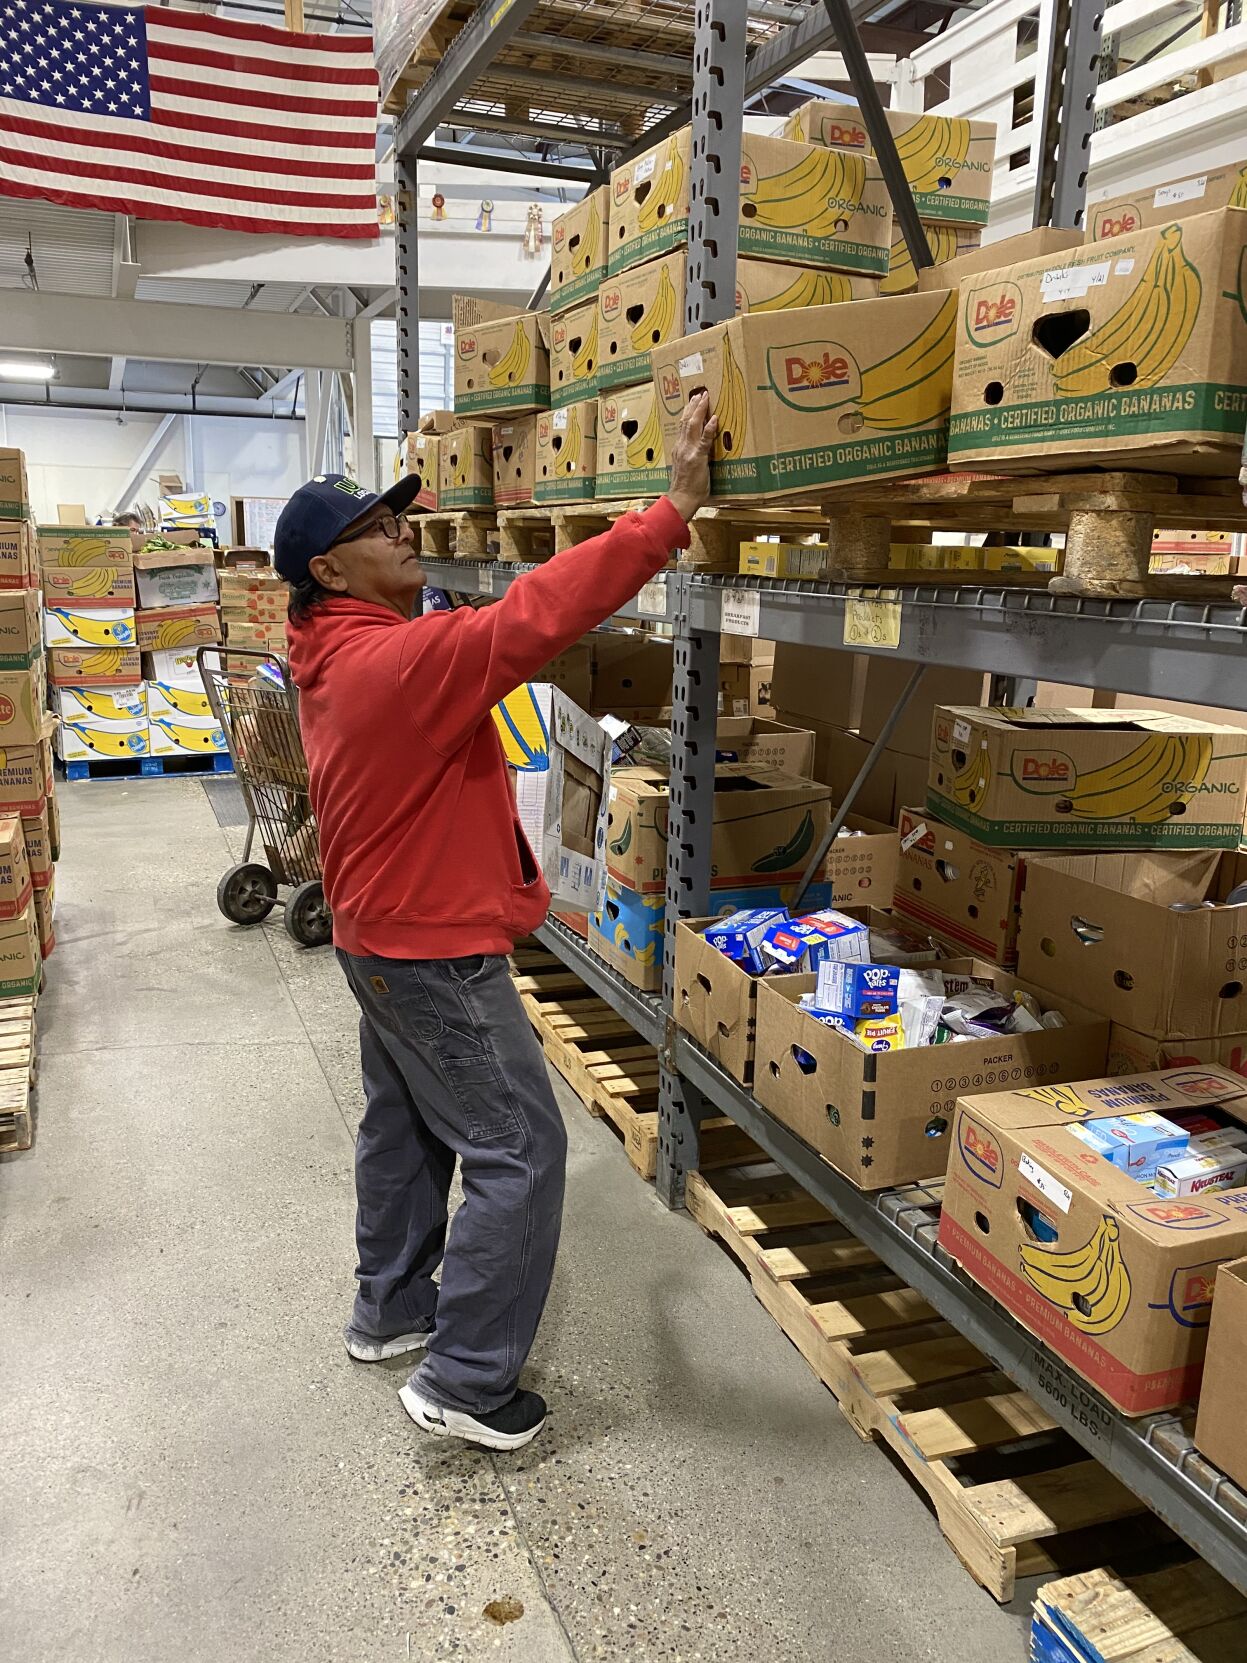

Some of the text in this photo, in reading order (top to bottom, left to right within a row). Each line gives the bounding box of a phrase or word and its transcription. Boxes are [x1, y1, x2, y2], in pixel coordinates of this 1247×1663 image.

[830, 124, 866, 144] Dole
[935, 157, 990, 172] ORGANIC
[827, 197, 887, 217] ORGANIC
[926, 195, 959, 208] CERTIFIED
[961, 199, 990, 211] ORGANIC
[1101, 213, 1135, 237] Dole
[739, 227, 774, 242] ORGANIC
[776, 234, 813, 248] BANANAS
[820, 240, 857, 254] CERTIFIED
[858, 246, 889, 260] ORGANIC
[1087, 253, 1105, 262] FRUIT
[604, 293, 620, 309] Dole
[975, 298, 1015, 326] Dole
[785, 352, 849, 386] Dole
[663, 373, 679, 394] Dole
[605, 408, 616, 420] Dole
[950, 391, 1196, 436] BANANAS CERTIFIED ORGANIC BANANAS
[770, 452, 833, 475] CERTIFIED
[836, 441, 891, 464] ORGANIC
[730, 463, 757, 479] BANANAS
[724, 612, 751, 620] BREAKFAST
[1022, 758, 1069, 777] Dole
[1161, 781, 1239, 794] ORGANIC
[901, 815, 936, 850] De
[1003, 823, 1240, 837] CERTIFIED ORGANIC BANANAS CERTIFIED ORGANIC
[2, 979, 32, 989] ORGANIC
[866, 1027, 897, 1037] FRUIT PIE
[984, 1054, 1013, 1065] PACKER
[1088, 1082, 1156, 1098] BANANAS
[1101, 1092, 1172, 1108] PREMIUM
[964, 1126, 999, 1168] Dole
[1146, 1205, 1204, 1221] Dole
[951, 1229, 1107, 1368] PREMIUM BANANAS PREMIUM BANANAS
[1034, 1353, 1112, 1426] MAX. LOAD
[1038, 1374, 1101, 1440] 5600 LBS.
